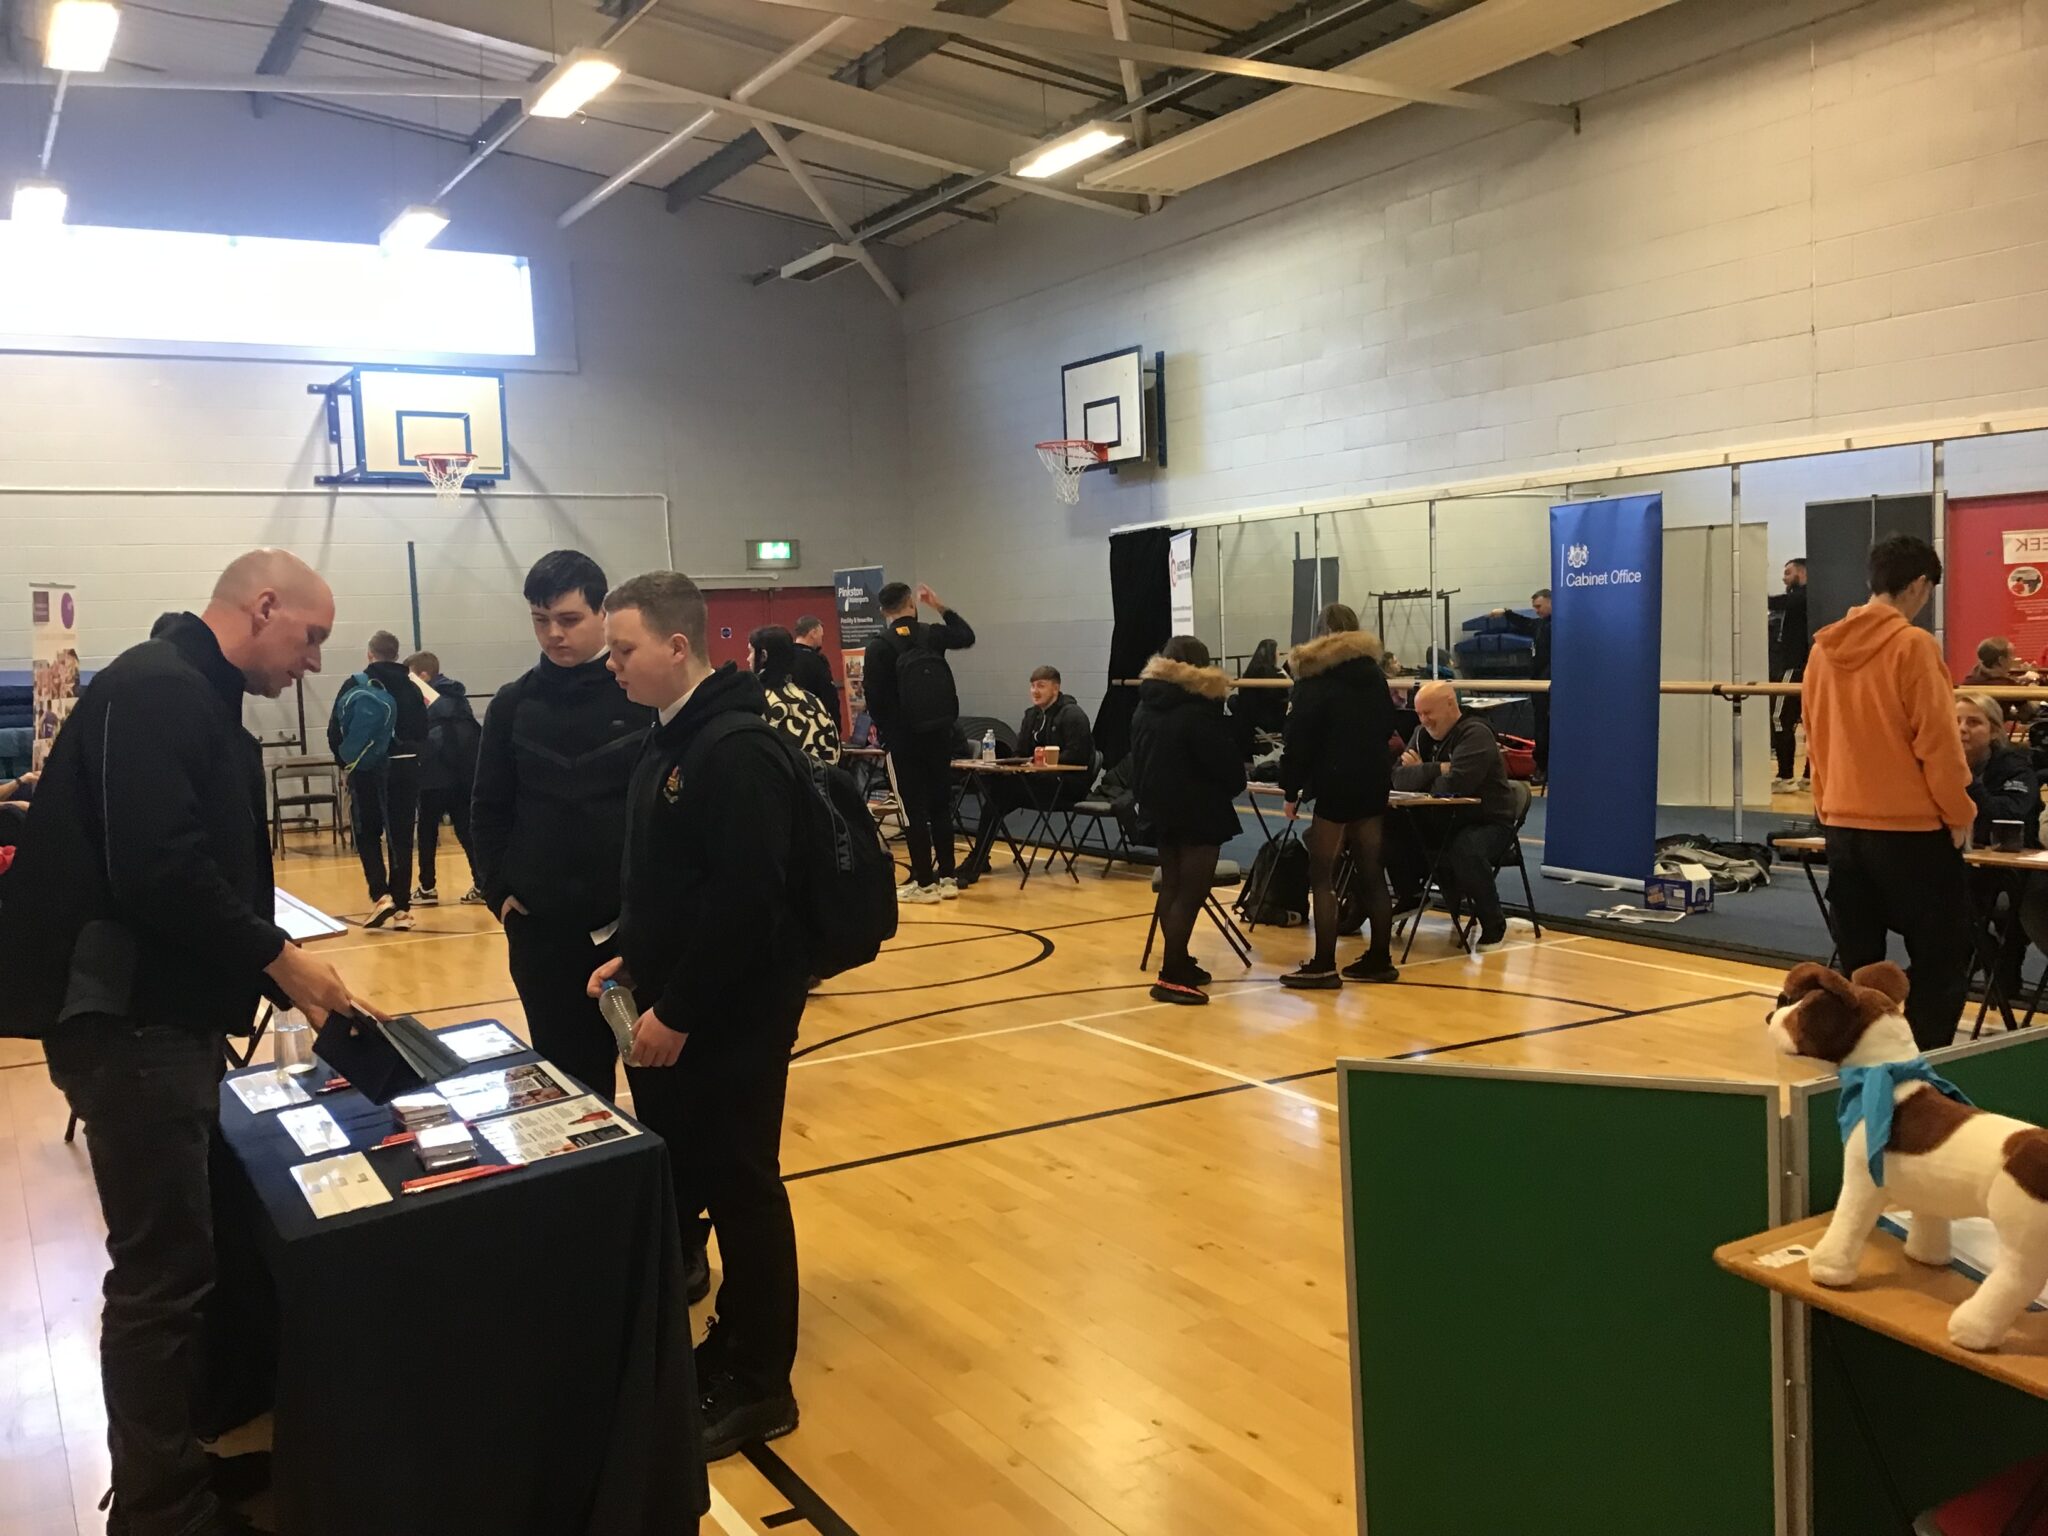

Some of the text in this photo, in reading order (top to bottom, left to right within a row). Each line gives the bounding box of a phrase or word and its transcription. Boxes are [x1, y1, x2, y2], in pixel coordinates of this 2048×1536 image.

[1566, 569, 1642, 587] Cabinet Office
[838, 586, 863, 597] Pinkston
